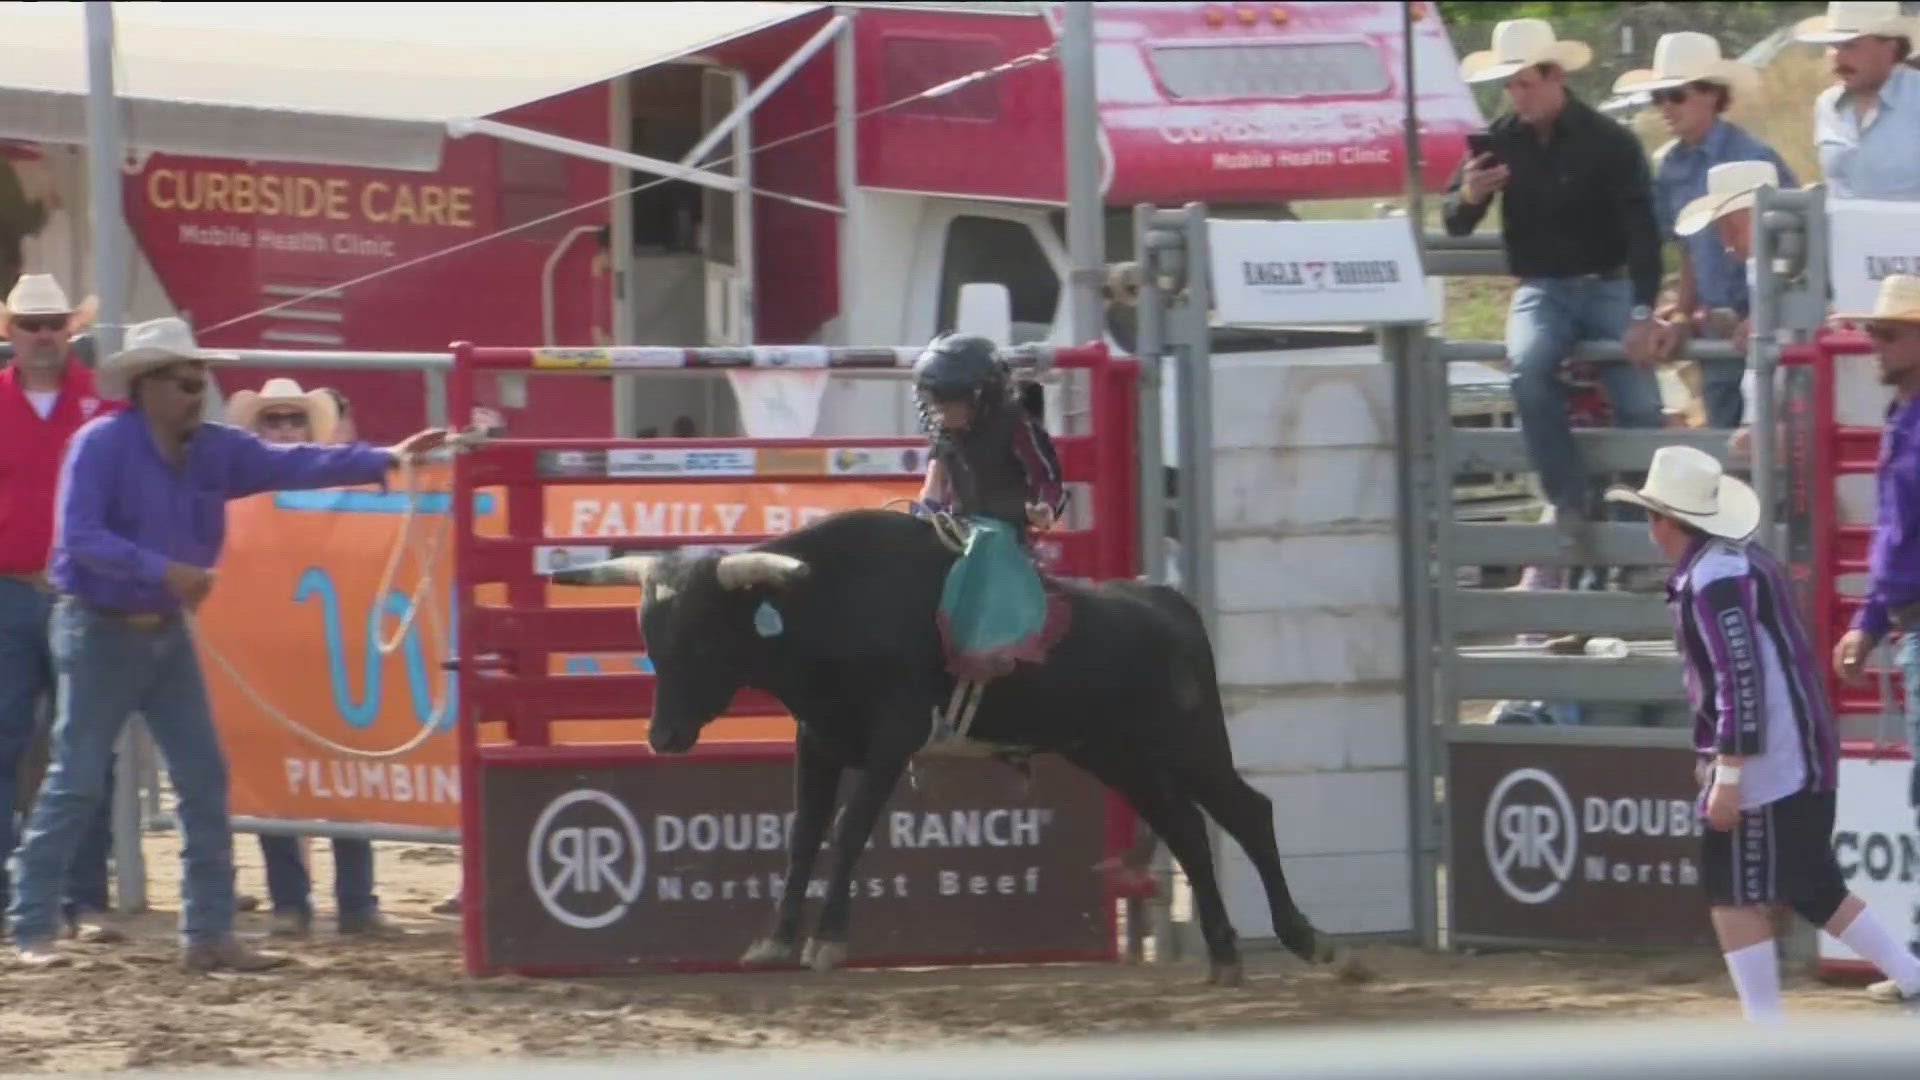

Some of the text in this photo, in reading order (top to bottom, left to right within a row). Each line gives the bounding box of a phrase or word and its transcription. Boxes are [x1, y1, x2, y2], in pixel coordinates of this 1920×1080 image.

[1212, 147, 1391, 169] Mobile Health Clinic
[148, 169, 475, 227] CURBSIDE CARE
[178, 224, 396, 257] Mobile Health Clinic
[1243, 261, 1304, 286] EAGLE
[569, 499, 748, 537] FAMILY
[938, 866, 1040, 895] Beef
